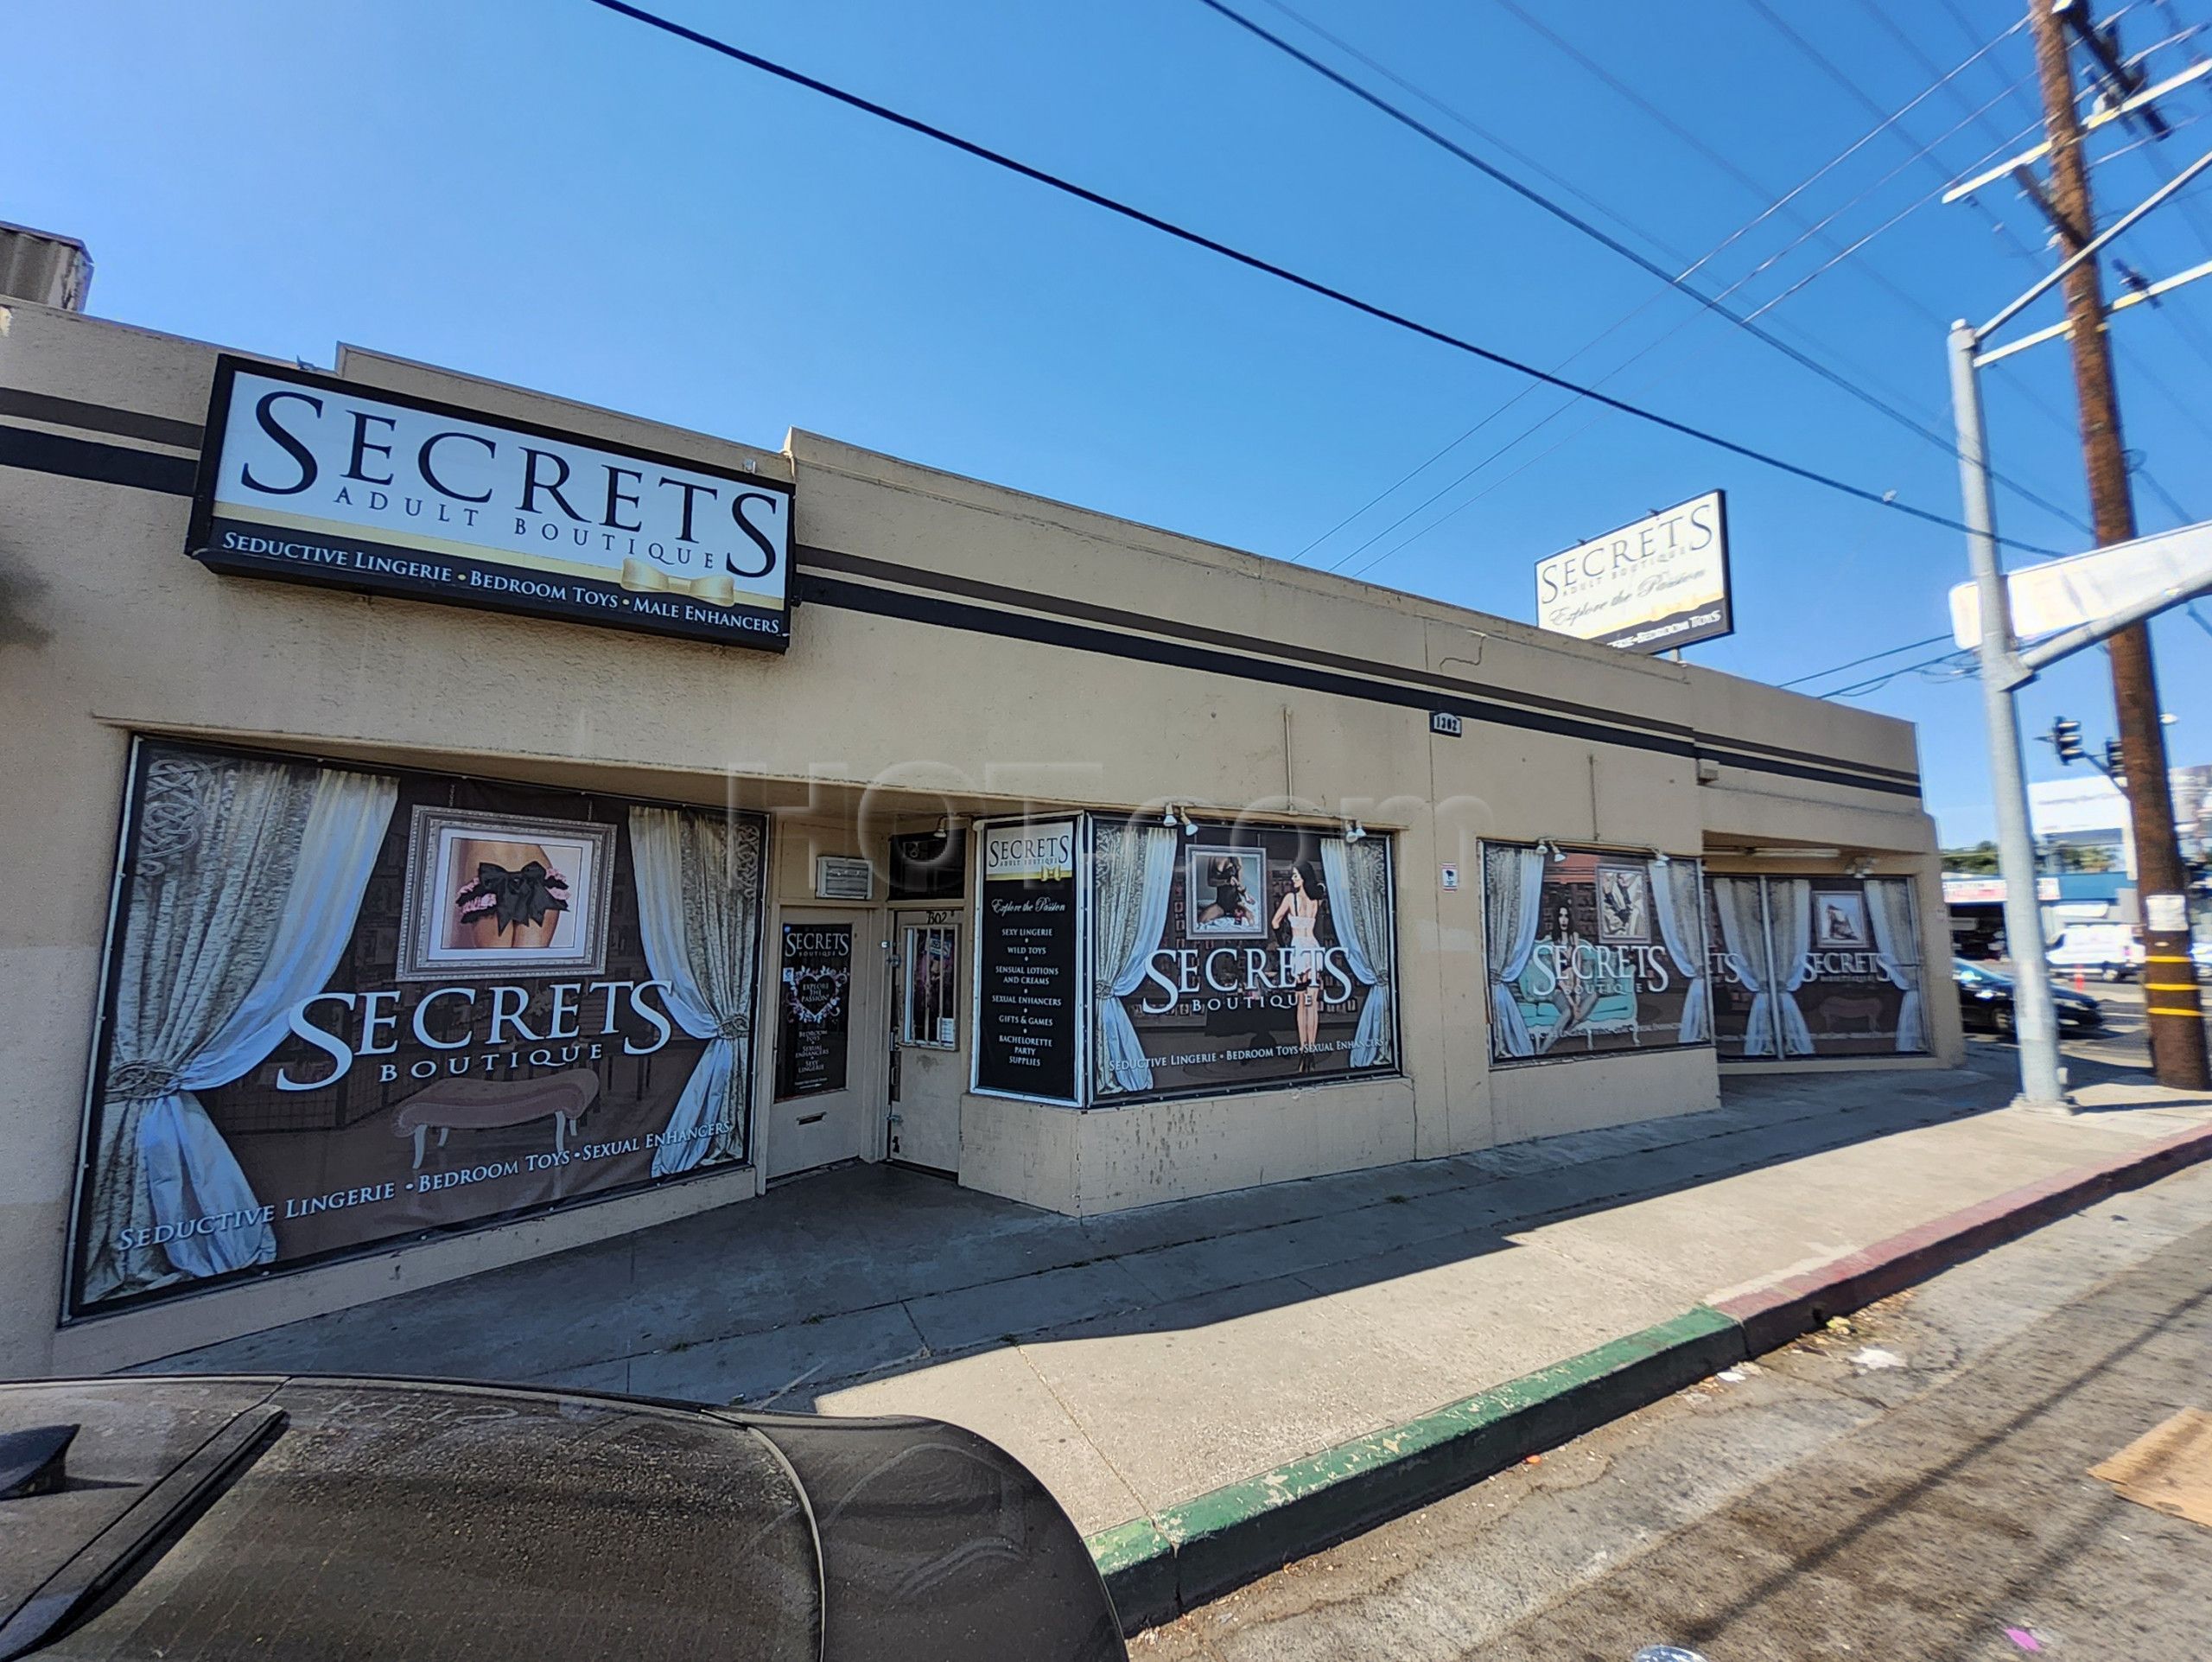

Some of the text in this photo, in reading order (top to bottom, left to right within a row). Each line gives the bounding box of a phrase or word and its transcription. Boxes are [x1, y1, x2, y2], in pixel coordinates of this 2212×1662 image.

[241, 391, 778, 578] SECRETS
[334, 486, 715, 570] ADULT BOUTIQUE
[1541, 505, 1713, 604] SECRETS
[222, 531, 780, 635] SEDUCTIVE LINGERIE BEDROOM TOYS MALE ENHANCERS
[988, 835, 1070, 868] SECRETS
[991, 896, 1065, 917] Explore the Passion
[785, 933, 849, 957] SECRETS
[995, 965, 1024, 974] SENSUAL
[1141, 947, 1353, 1014] SECRETS
[1532, 945, 1669, 996] SECRETS
[1802, 952, 1891, 983] SECRETS
[992, 995, 1062, 1006] SEXUAL ENHANCERS
[1192, 994, 1313, 1012] BOUTIQUE
[1565, 983, 1643, 995] BOUTIQE
[999, 1015, 1053, 1026] GIFTS & GAMES
[276, 980, 675, 1092] SECRETS
[999, 1035, 1052, 1047] BACHELORETTE
[1014, 1046, 1036, 1055] PARTY
[379, 1044, 604, 1083] BOUTIQUE
[1009, 1056, 1040, 1067] SUPPLIES
[1109, 1057, 1167, 1071] SEDUCTIVE
[1171, 1052, 1217, 1066] LINGERIE
[1226, 1048, 1274, 1061] BEDROOM
[1276, 1045, 1299, 1055] TOYS
[1304, 1042, 1333, 1054] SEXUAL
[118, 1120, 731, 1251] SEDUCTIVE LINGERIE BEDROOM TOYS SEXUAL ENHANCERS
